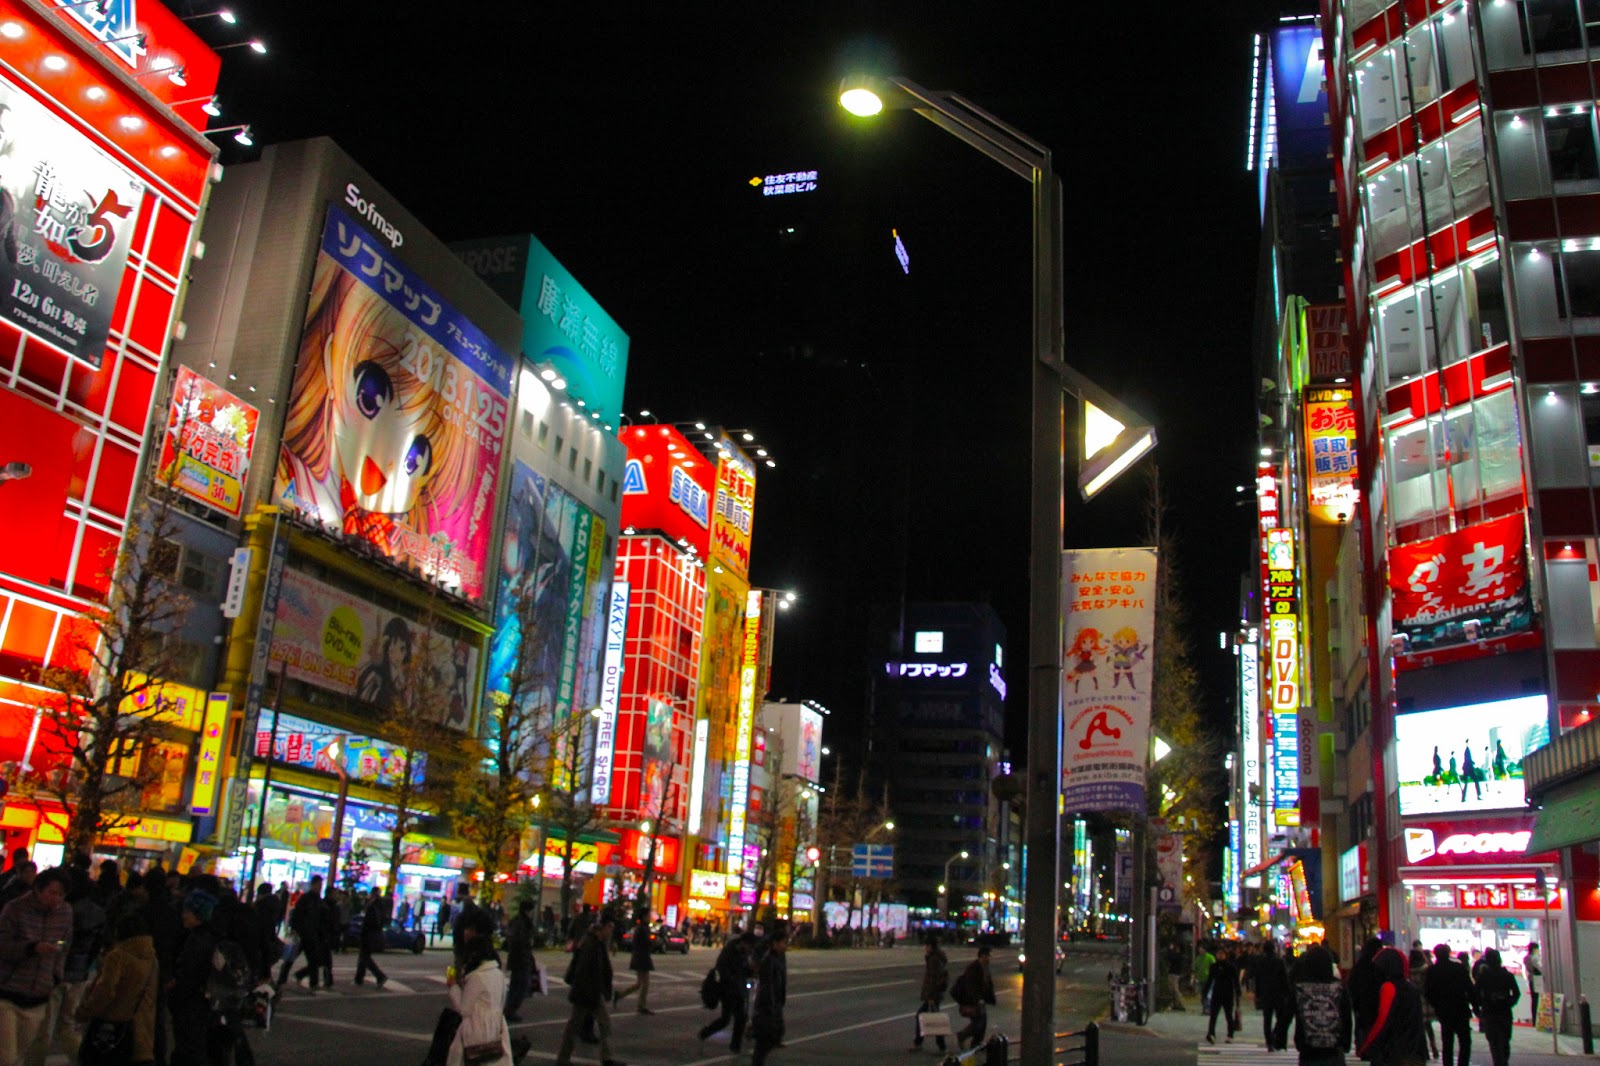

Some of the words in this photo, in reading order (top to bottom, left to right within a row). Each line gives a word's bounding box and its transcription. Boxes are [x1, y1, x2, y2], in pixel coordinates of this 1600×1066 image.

[763, 182, 817, 196] 秋葉原ビル
[764, 170, 818, 185] 住友不動産
[345, 183, 403, 248] Sofmap
[338, 221, 442, 326] ソフマップ
[401, 333, 505, 438] 2013.1.25
[1309, 390, 1332, 402] DVD
[443, 407, 461, 426] ON
[465, 422, 494, 450] SALE
[669, 465, 708, 530] SEGA
[1070, 570, 1146, 583] みんなで協力
[609, 590, 626, 642] AKKY
[1069, 598, 1145, 613] 元気なアキバ
[604, 665, 617, 707] DUTY
[885, 661, 968, 677] ソフマップ
[1275, 638, 1295, 705] DVD
[599, 711, 614, 750] FREE
[1302, 718, 1314, 776] docomo
[199, 749, 216, 785] 松屋
[594, 755, 609, 797] SHOP
